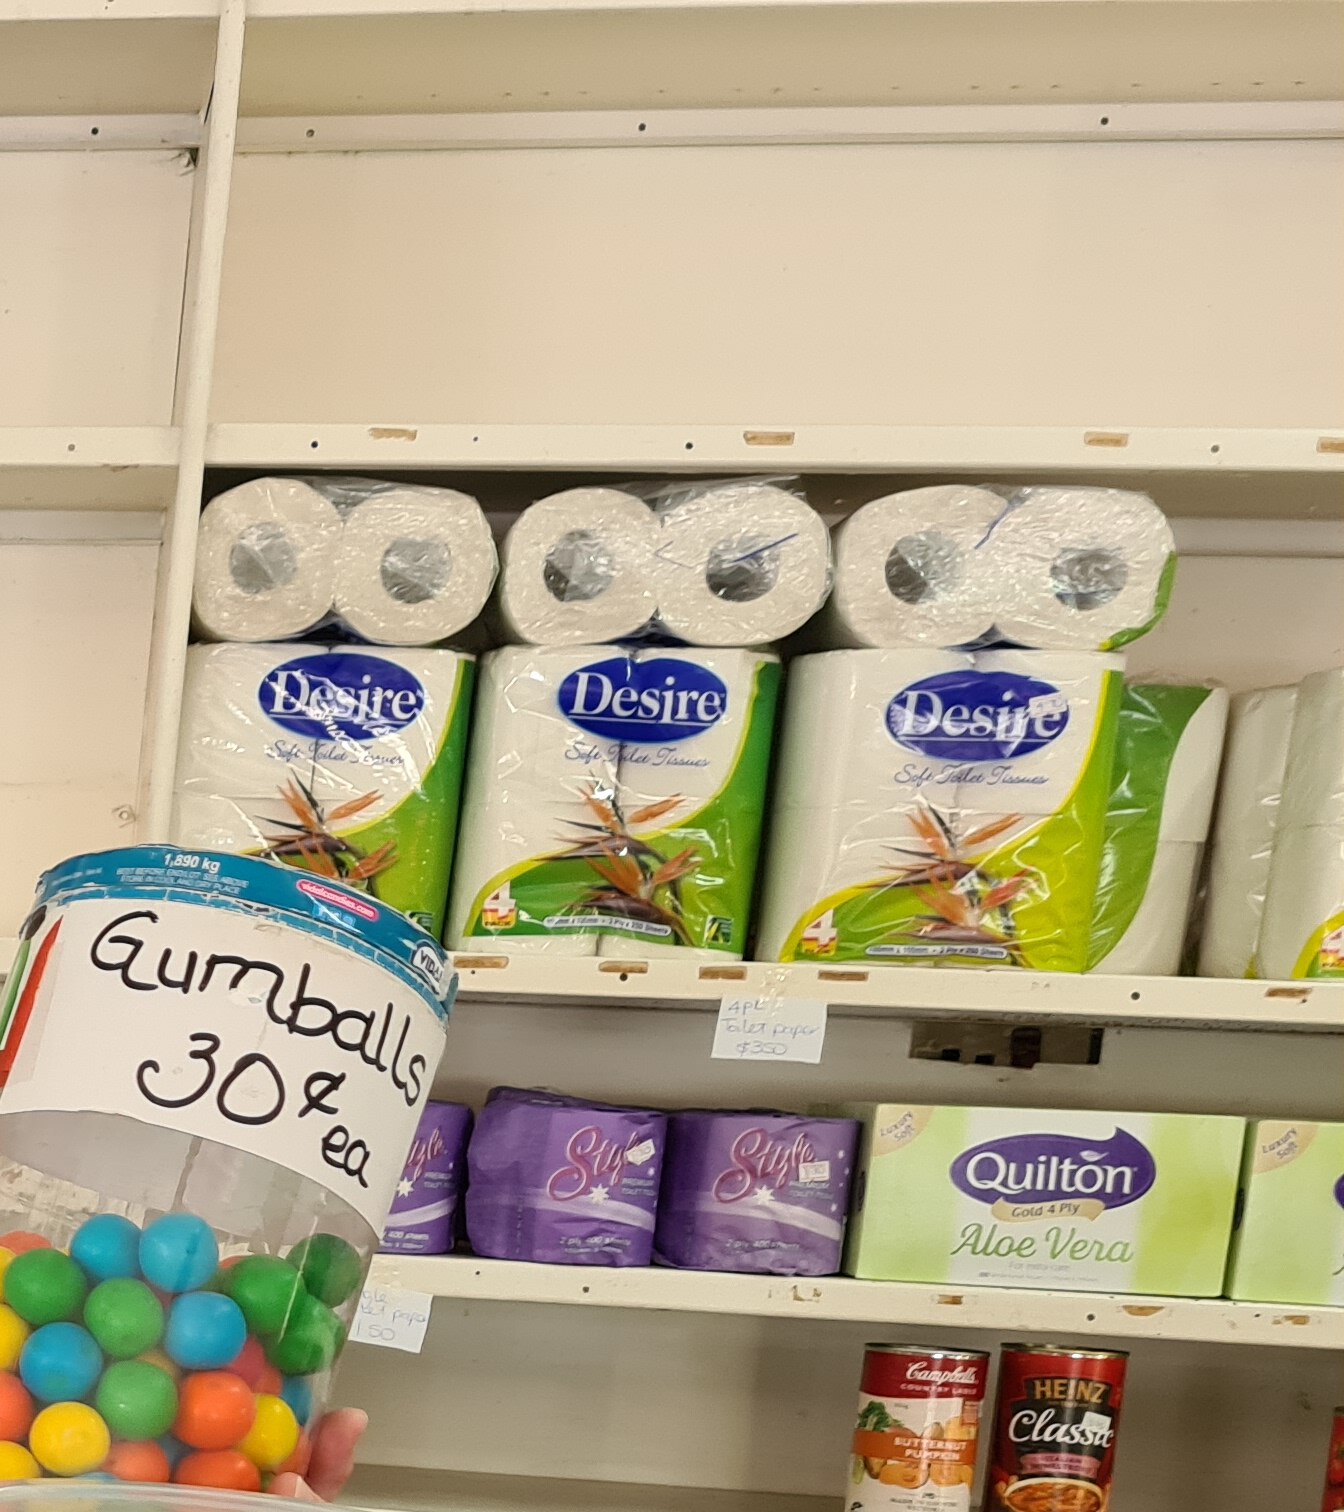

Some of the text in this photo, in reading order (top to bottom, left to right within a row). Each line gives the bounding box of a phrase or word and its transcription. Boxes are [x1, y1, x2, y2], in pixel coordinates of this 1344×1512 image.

[269, 670, 420, 723] Desire
[568, 671, 723, 724] Desire
[565, 741, 602, 765] Soft
[652, 747, 710, 768] Tissues
[894, 764, 934, 787] Soft
[987, 765, 1050, 786] Tissues
[201, 857, 221, 874] kg
[90, 909, 428, 1107] Gumballs
[320, 1125, 371, 1188] ea
[712, 1127, 818, 1204] Style
[966, 1151, 1133, 1195] Quilton
[1011, 1202, 1081, 1219] Gold 4 Ply
[949, 1222, 1134, 1264] Aloe Vera
[1034, 1379, 1108, 1404] HEINZ
[893, 1436, 968, 1451] BUTTERNUT
[904, 1449, 961, 1462] PUMPKIN
